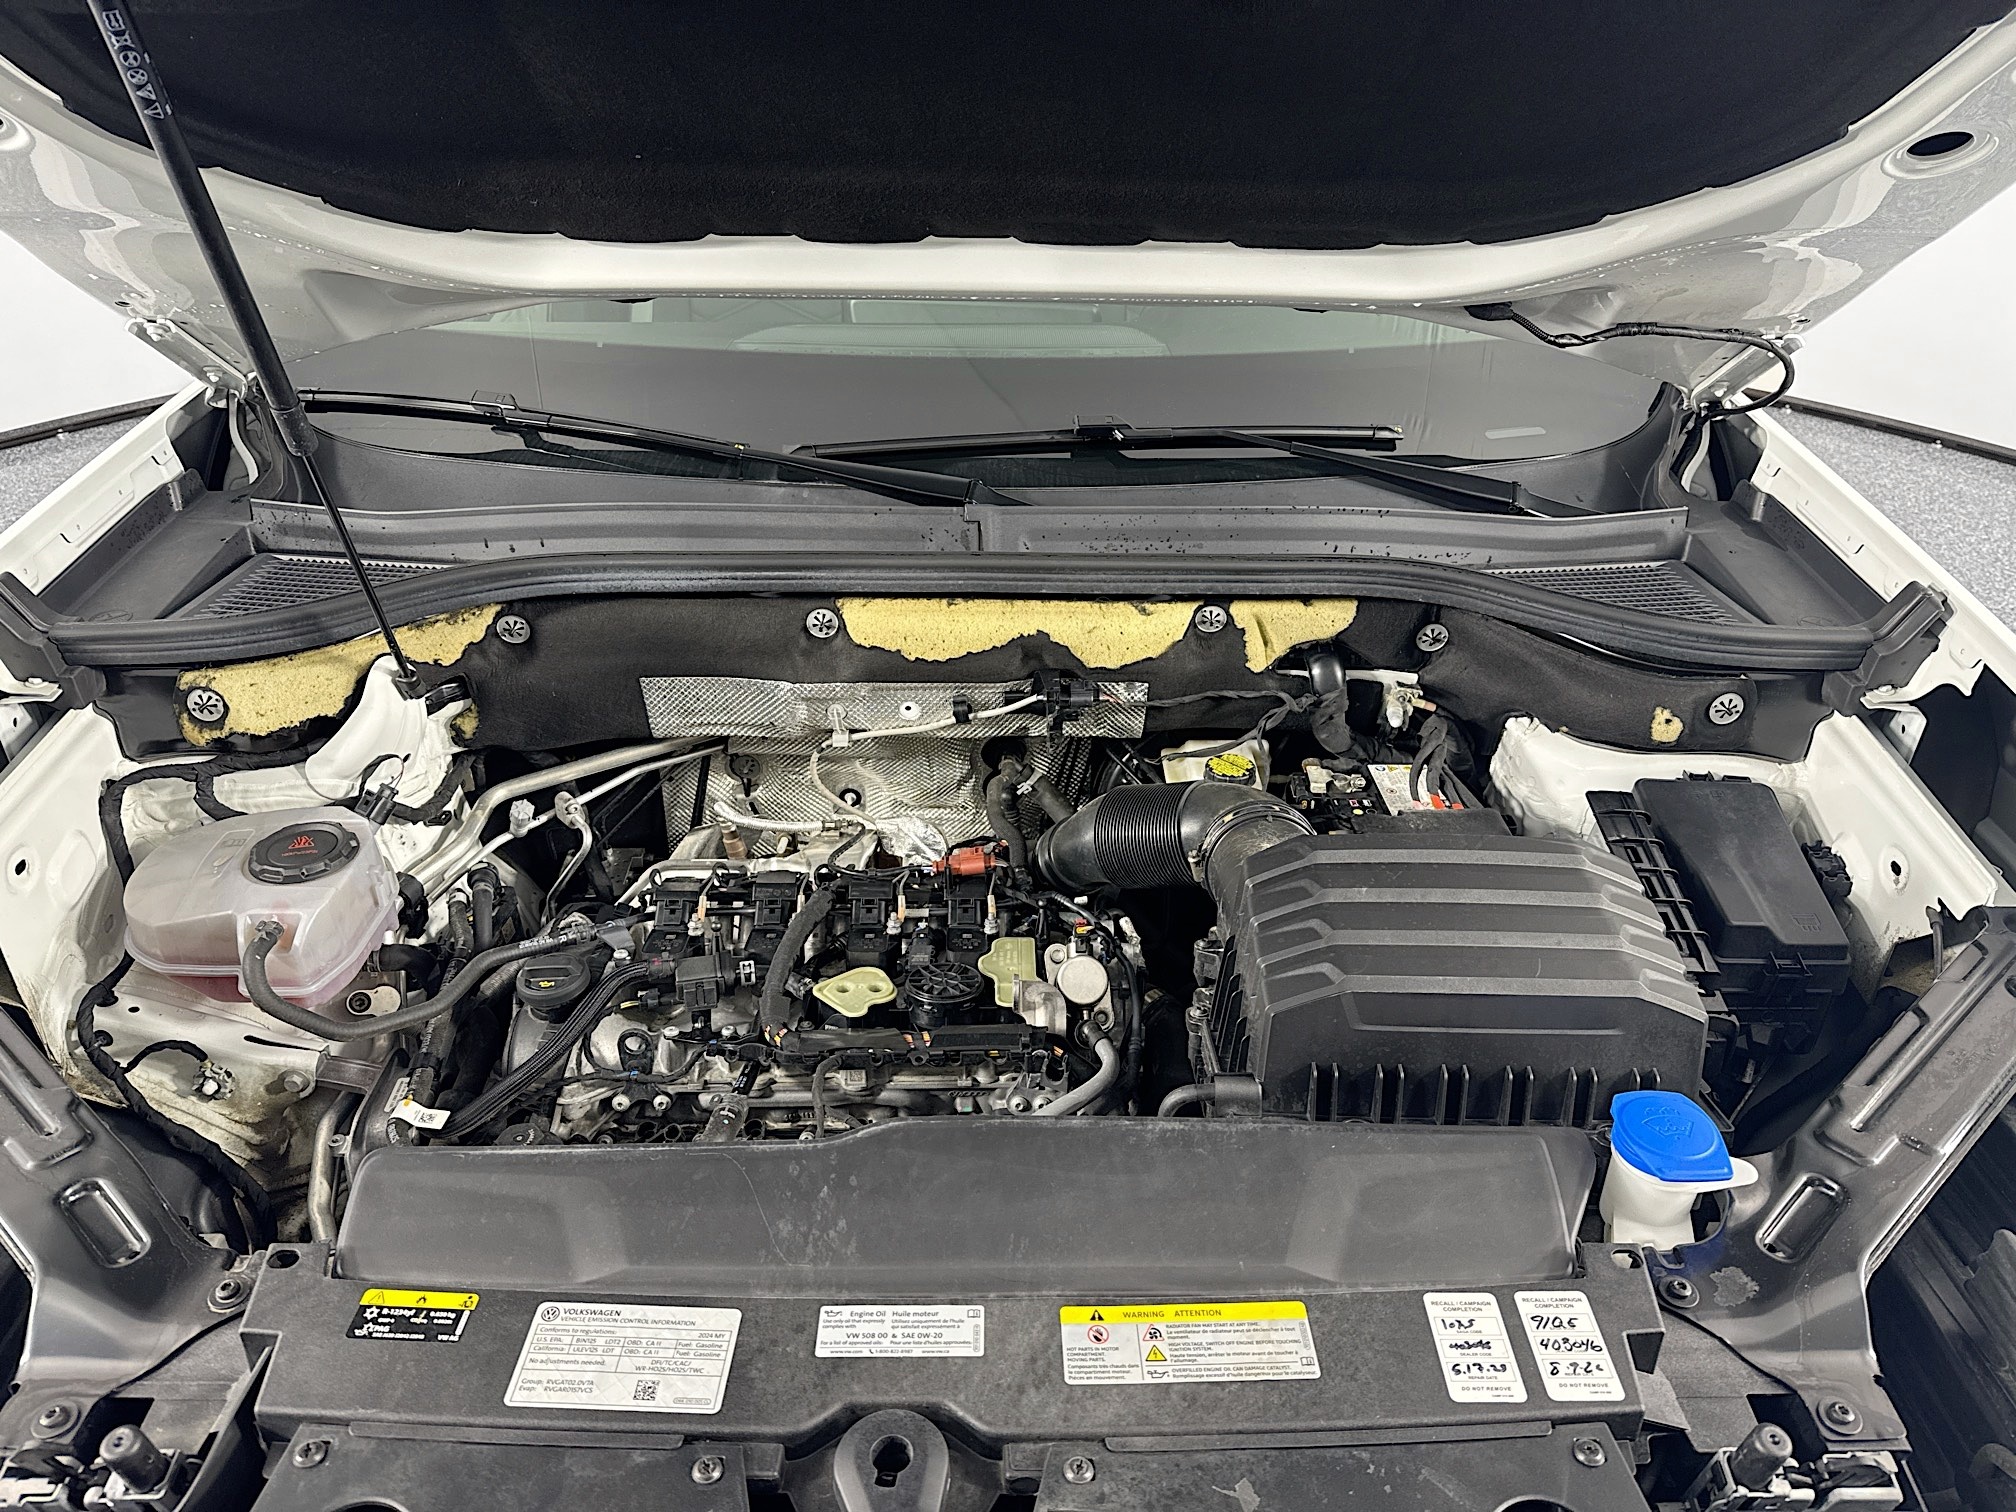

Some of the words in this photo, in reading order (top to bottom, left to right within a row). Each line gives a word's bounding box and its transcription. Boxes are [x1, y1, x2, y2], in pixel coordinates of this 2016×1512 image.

[563, 1308, 622, 1316] VOLKSWAGEN
[1122, 1310, 1165, 1318] WARNING
[1174, 1309, 1222, 1317] ATTENTION
